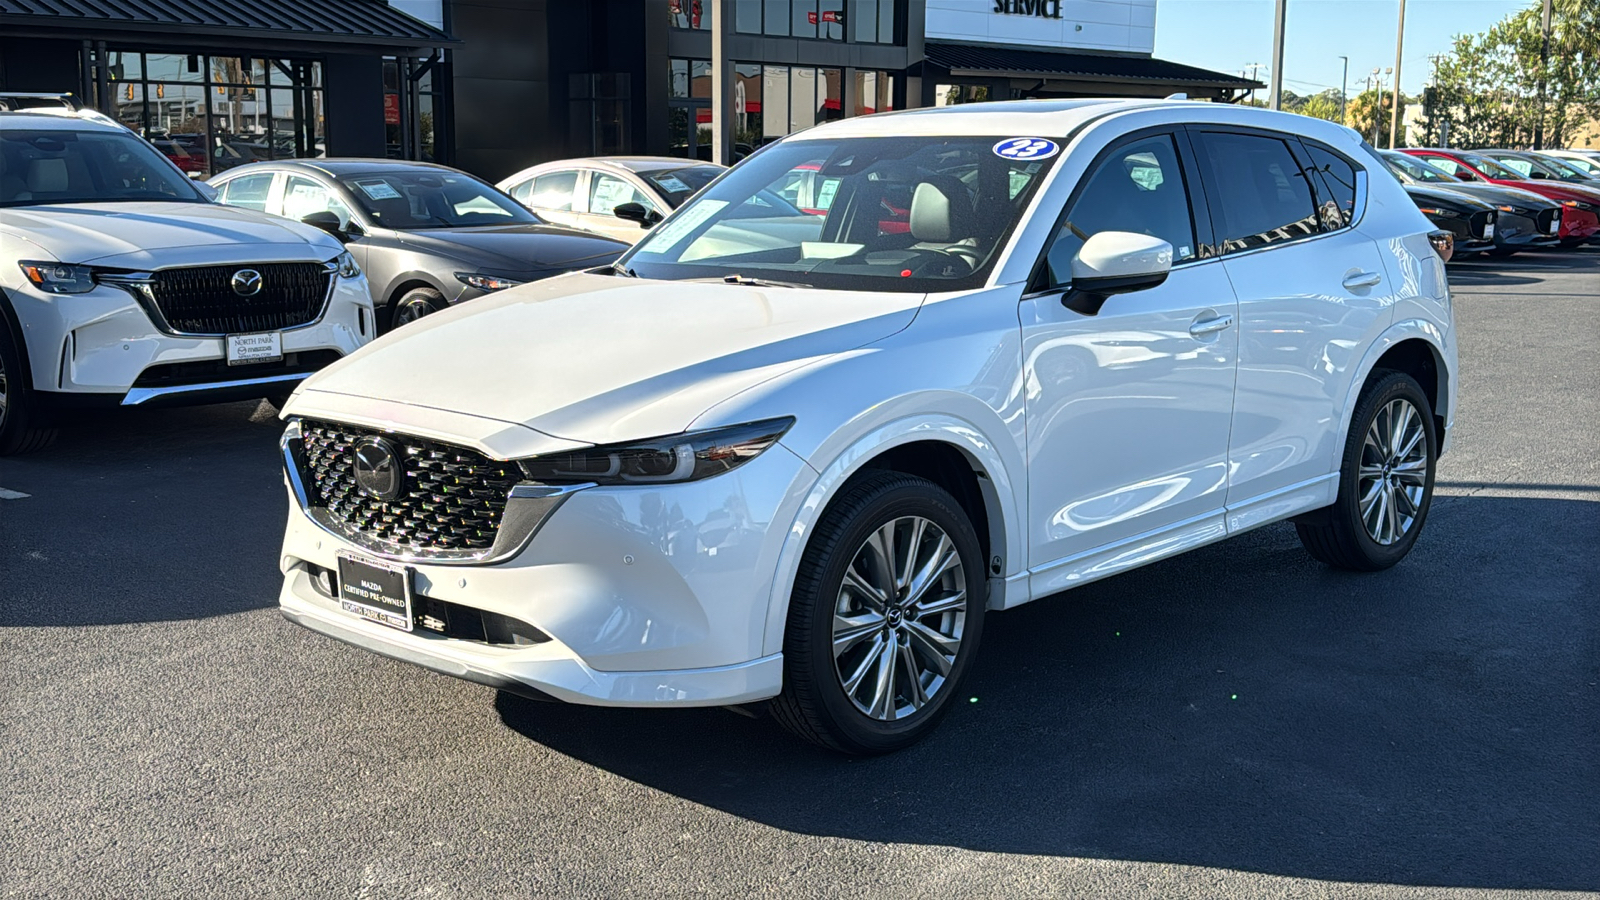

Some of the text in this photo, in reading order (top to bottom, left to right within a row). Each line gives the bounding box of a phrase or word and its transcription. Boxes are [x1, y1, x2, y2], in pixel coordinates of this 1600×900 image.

[993, 0, 1064, 19] SERVICE
[1001, 139, 1048, 157] 23
[234, 336, 274, 347] NORTH PARK
[361, 580, 383, 592] MAZDA
[344, 583, 405, 608] CERTIFIED PRE-OWNED
[343, 603, 363, 615] NORTH
[363, 608, 379, 620] PARK
